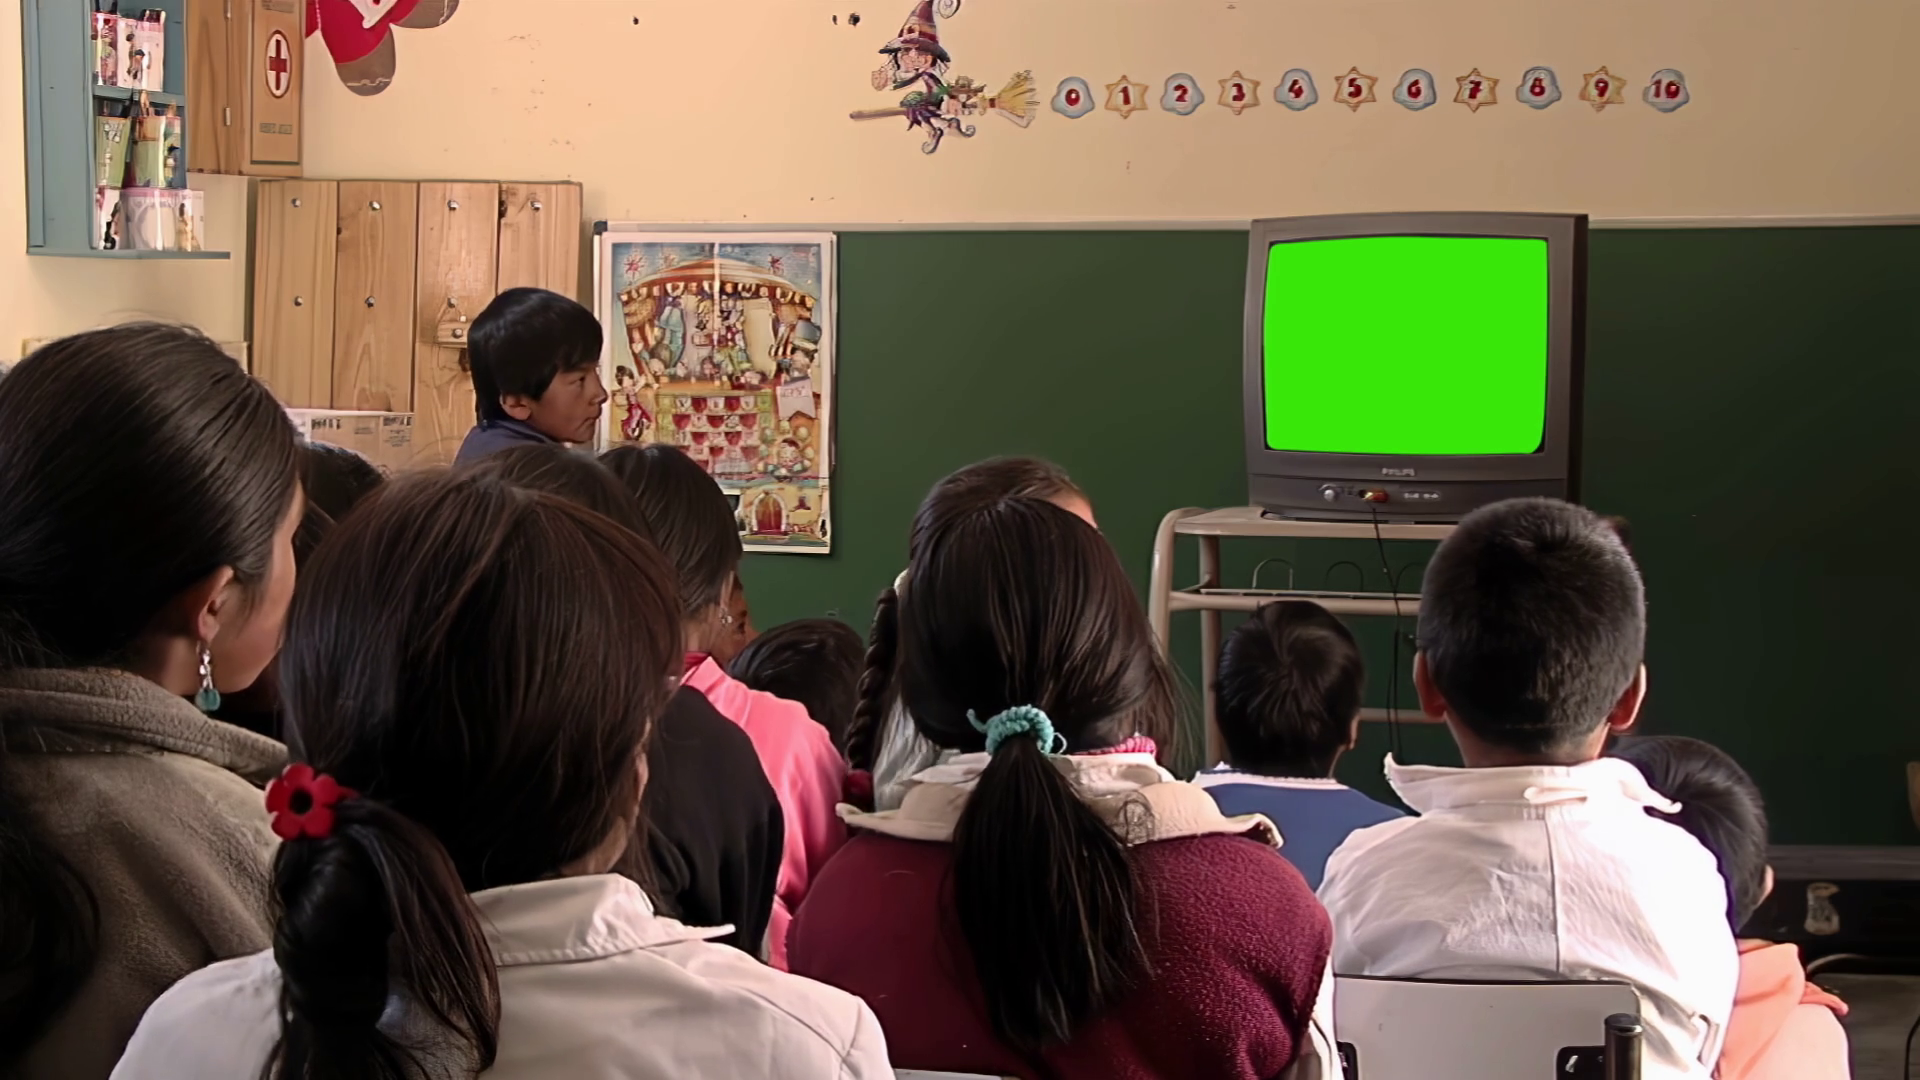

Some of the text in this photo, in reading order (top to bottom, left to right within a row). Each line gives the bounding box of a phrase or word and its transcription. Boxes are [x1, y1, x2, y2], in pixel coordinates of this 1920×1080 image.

[1065, 77, 1680, 106] 0 1 2 3 4 5 6 7 8 9 10
